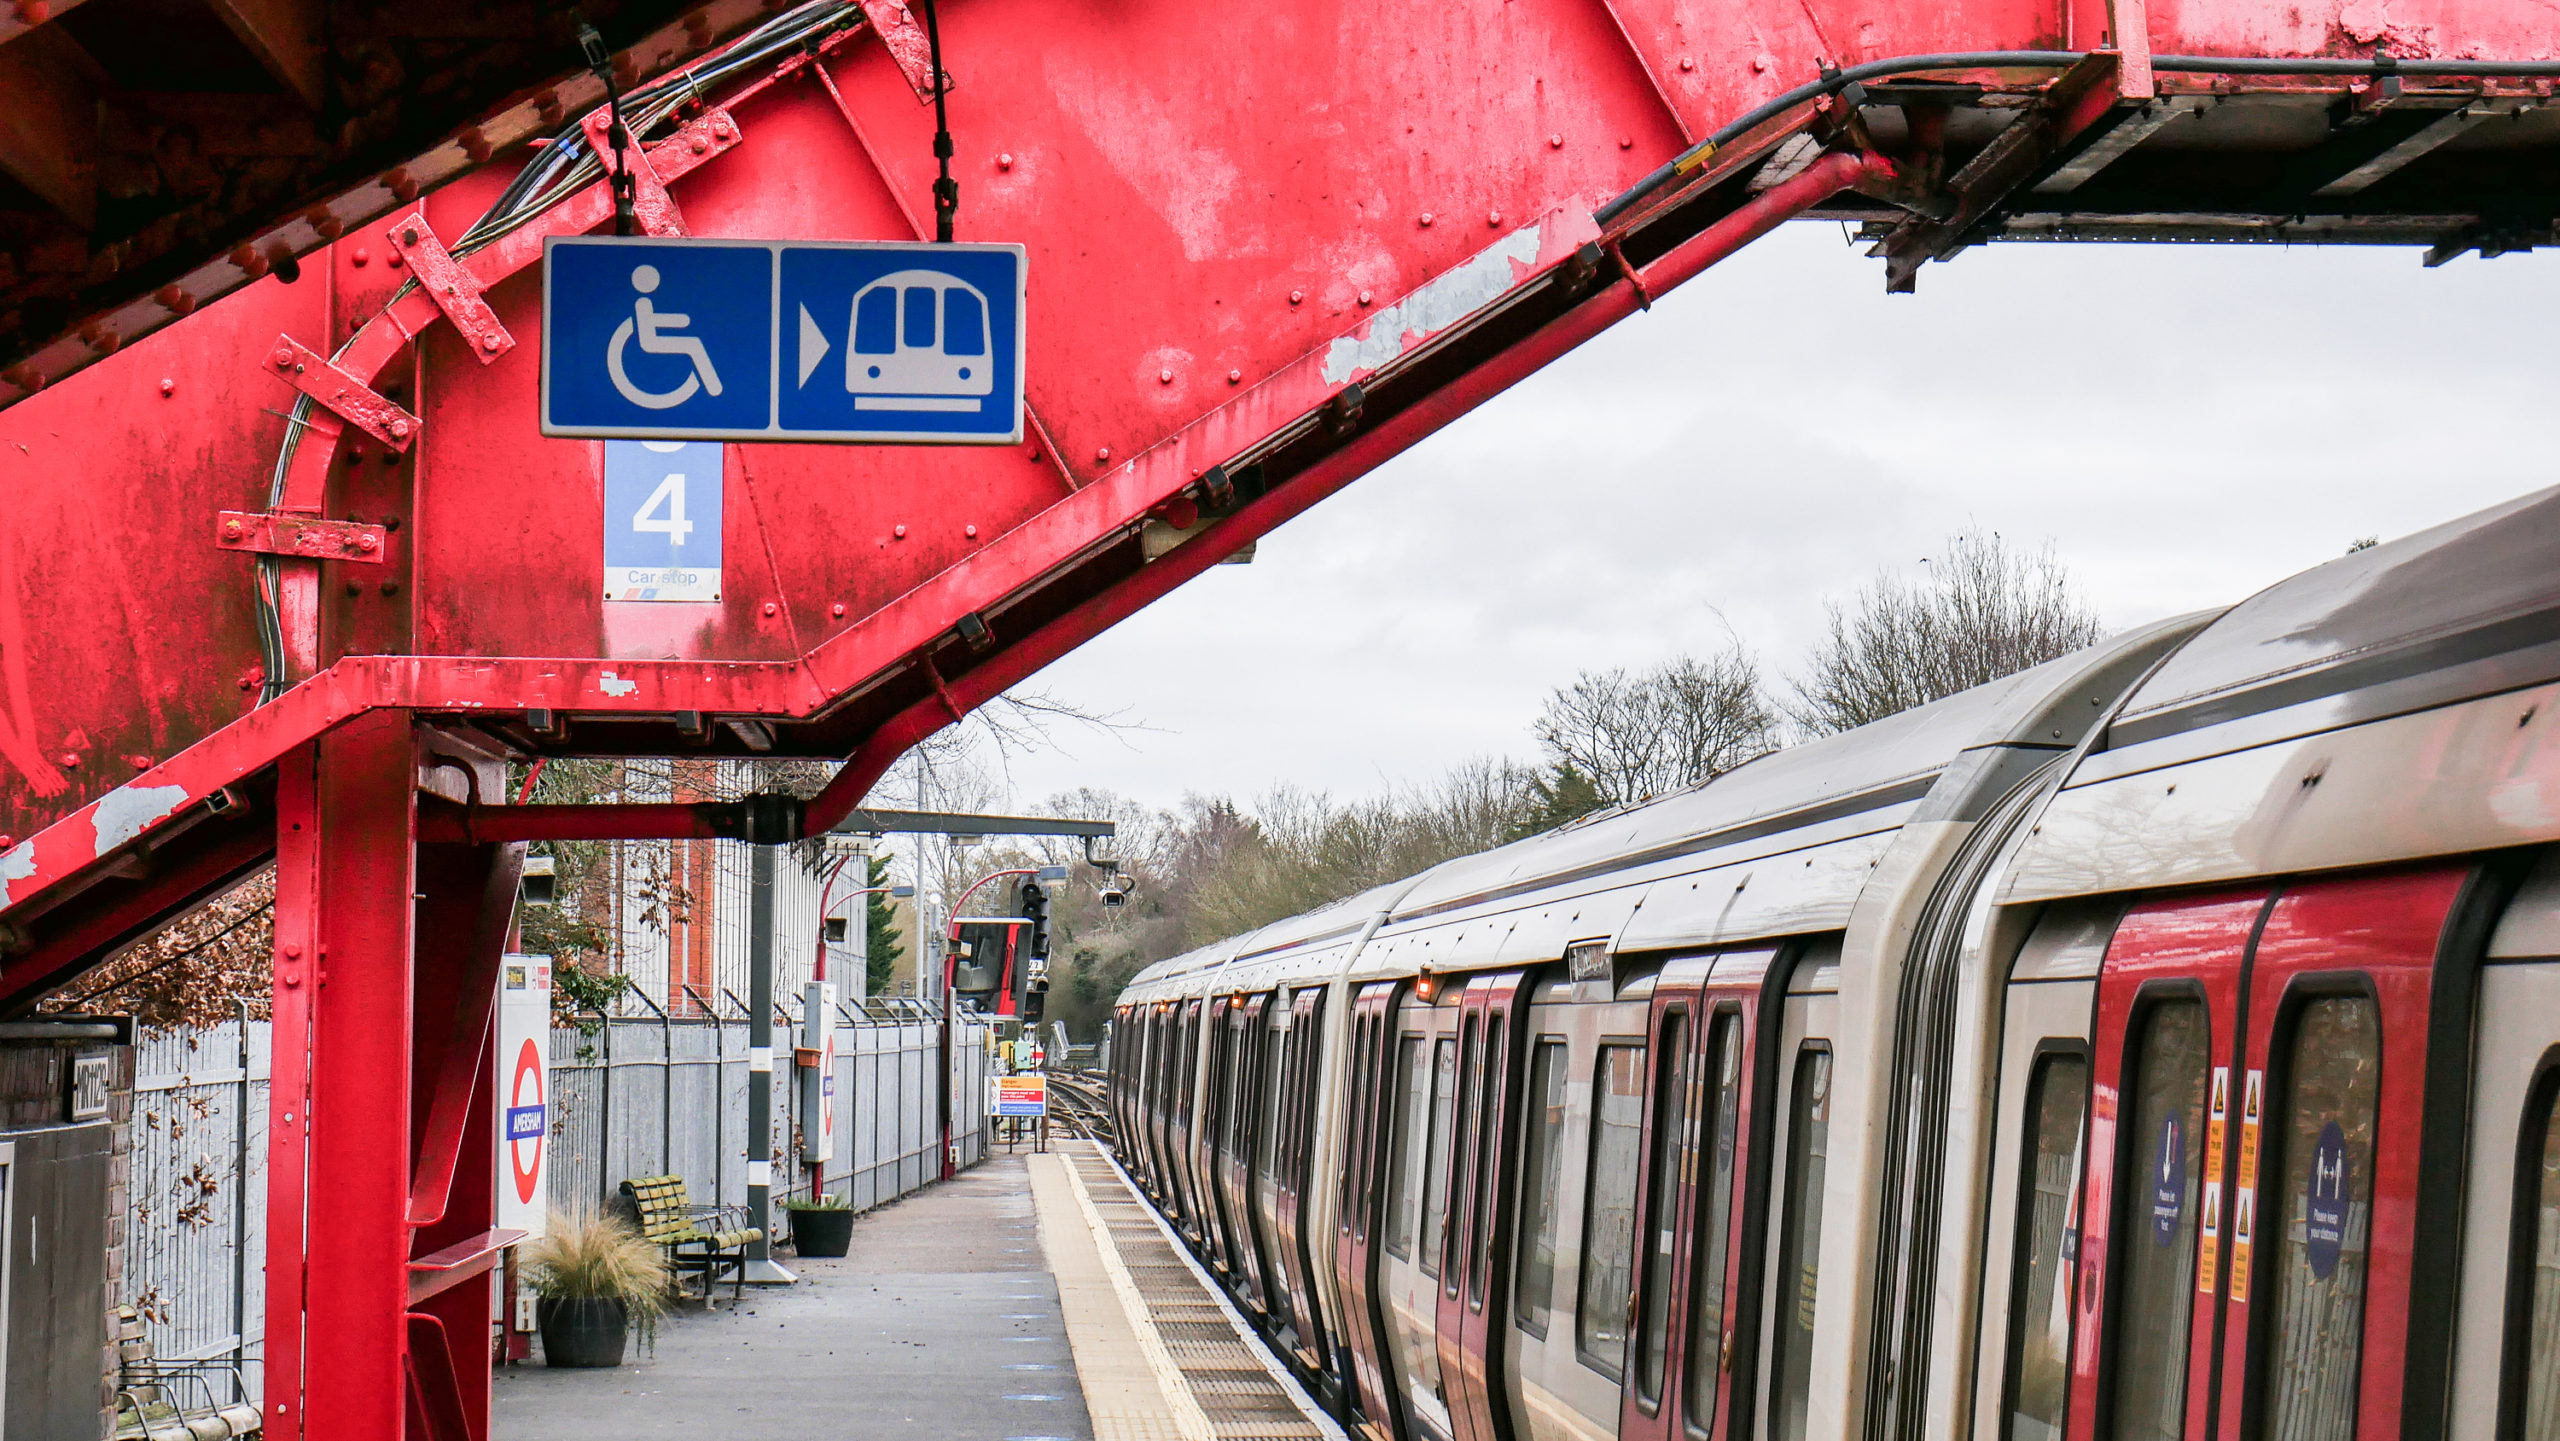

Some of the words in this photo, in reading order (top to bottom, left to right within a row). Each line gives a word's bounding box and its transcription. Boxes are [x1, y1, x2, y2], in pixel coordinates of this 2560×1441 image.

[633, 473, 693, 546] 4
[628, 570, 656, 584] Car
[662, 570, 698, 586] stop
[513, 1110, 541, 1133] AMERSHAM
